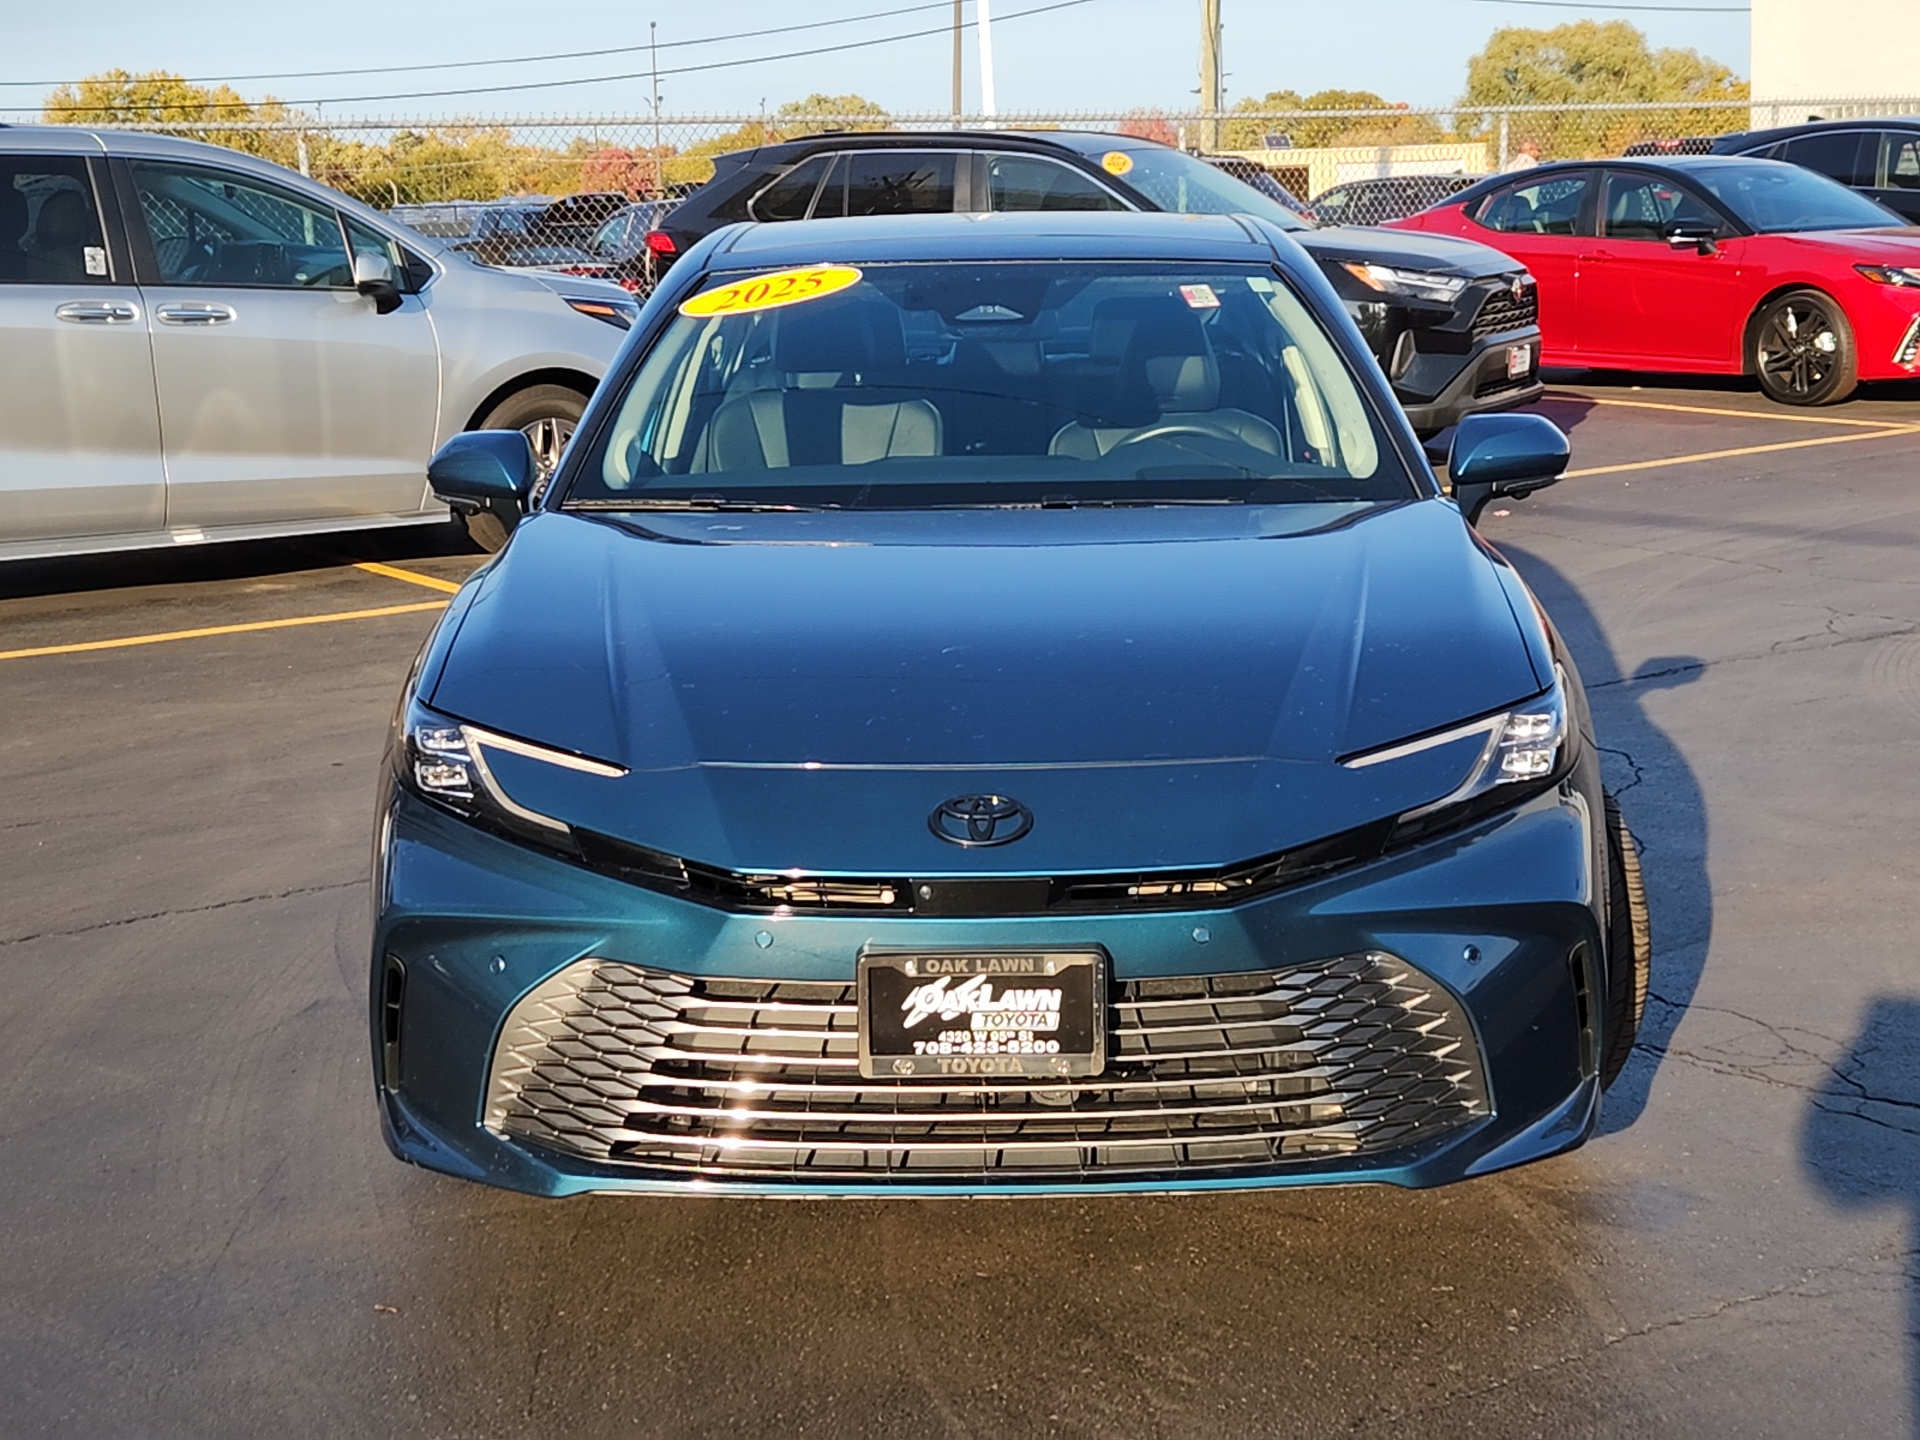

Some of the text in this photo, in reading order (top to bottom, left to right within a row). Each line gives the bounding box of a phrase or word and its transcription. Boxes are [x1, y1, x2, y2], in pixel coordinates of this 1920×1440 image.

[712, 270, 828, 312] 2025
[926, 959, 1035, 973] OAK LAWN
[981, 1014, 1048, 1027] TOYOTA
[938, 1030, 972, 1043] 4320
[973, 1031, 987, 1042] W
[1018, 1030, 1034, 1042] St
[913, 1040, 1060, 1056] 708-423-5200
[937, 1057, 1024, 1073] TOYOTA
